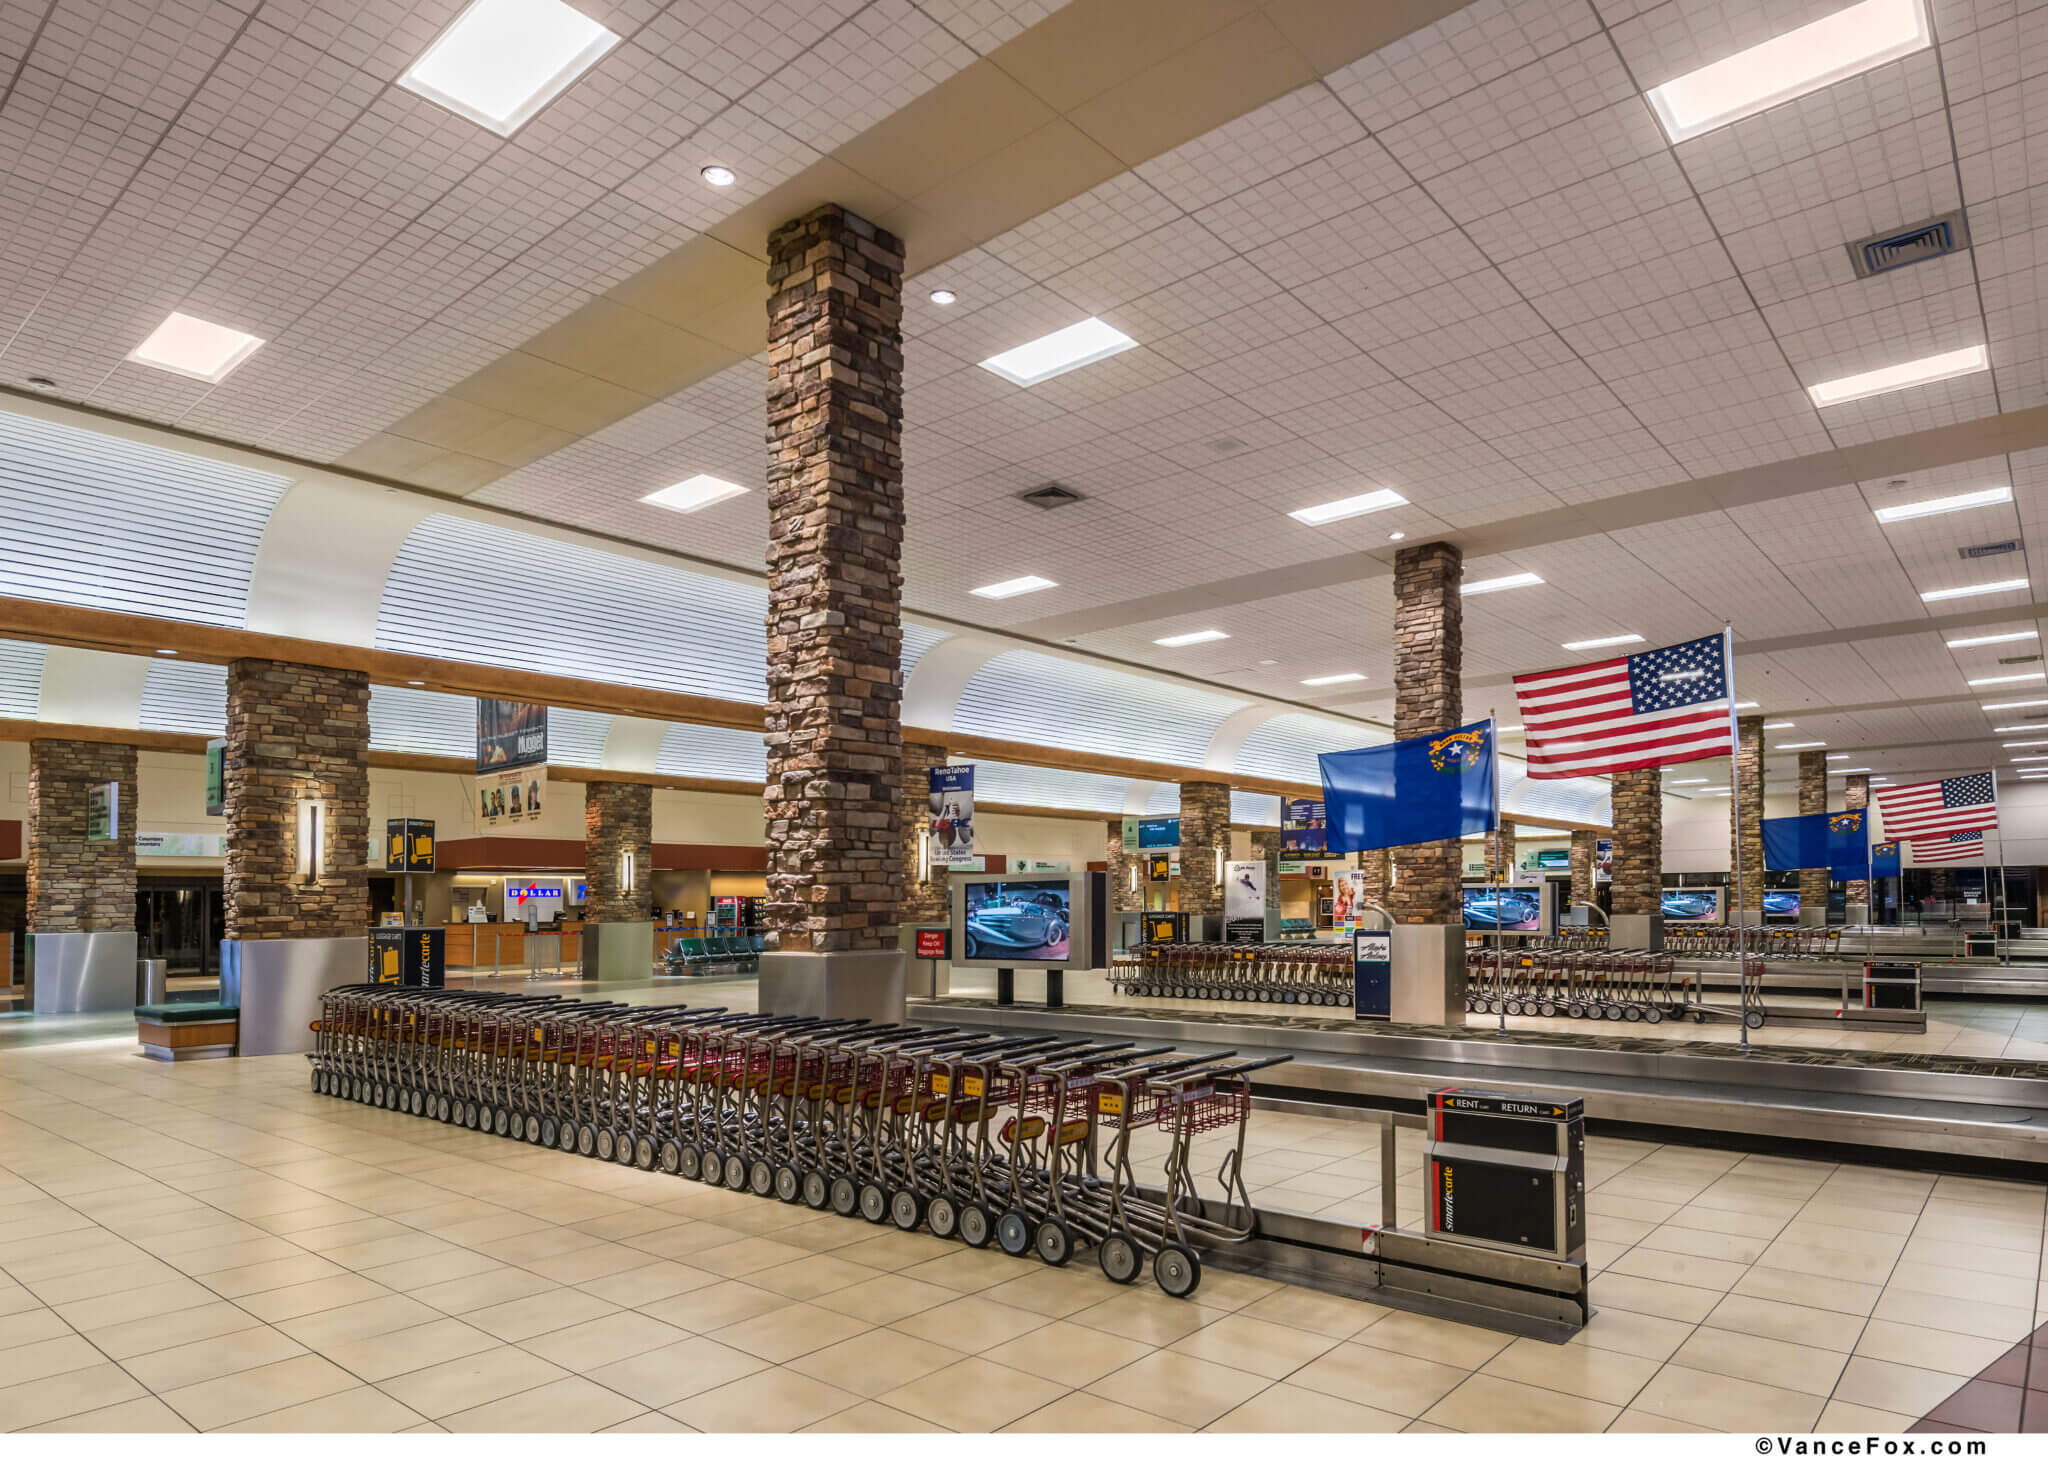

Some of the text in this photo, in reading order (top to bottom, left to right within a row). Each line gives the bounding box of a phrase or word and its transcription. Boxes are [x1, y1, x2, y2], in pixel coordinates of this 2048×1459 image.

[518, 732, 544, 754] Nugget
[511, 889, 559, 897] DOLLAR
[1456, 1098, 1479, 1109] RENT
[1501, 1103, 1538, 1114] RETURN
